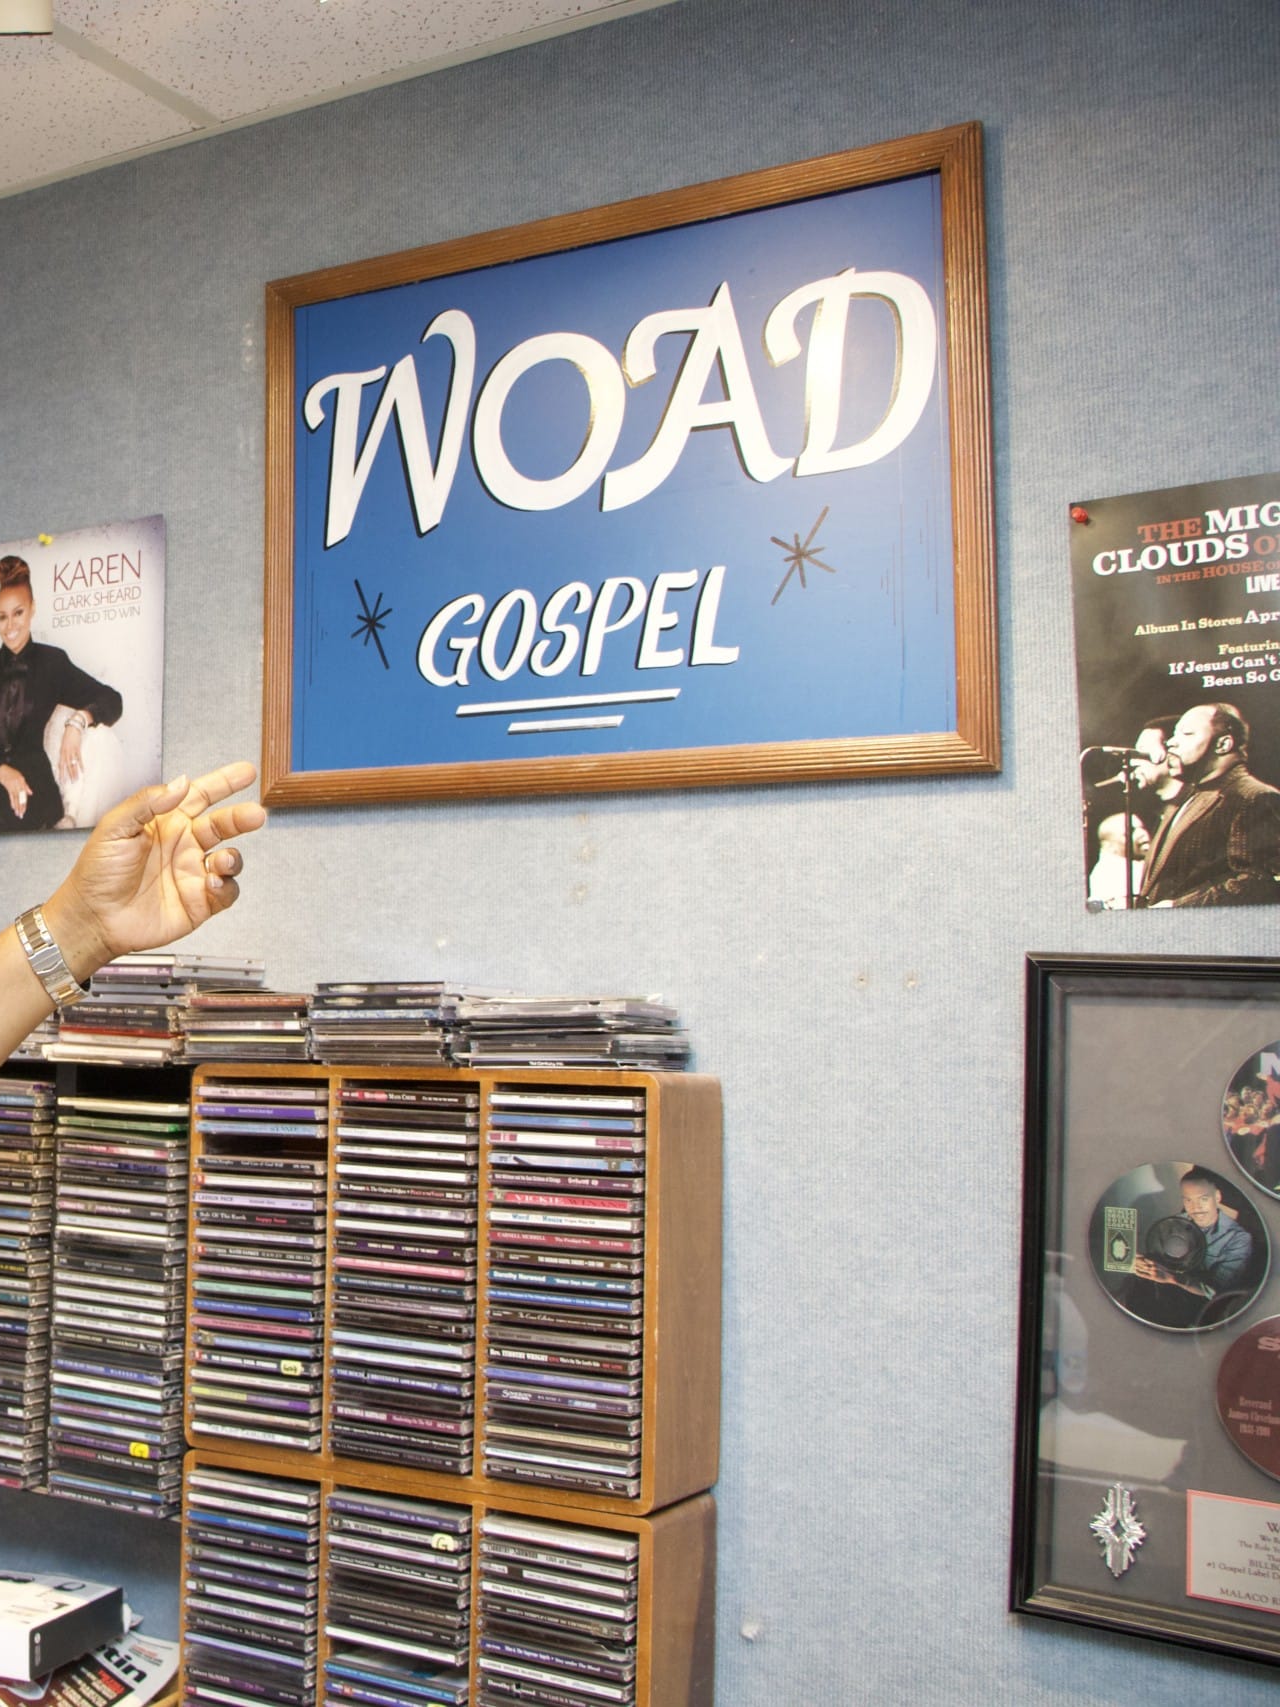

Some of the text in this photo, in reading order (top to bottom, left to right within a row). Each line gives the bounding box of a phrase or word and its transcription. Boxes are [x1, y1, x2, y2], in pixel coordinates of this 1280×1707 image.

[303, 267, 939, 551] WOAD
[1137, 517, 1202, 544] THE
[1092, 533, 1249, 576] CLOUDS
[53, 549, 141, 592] KAREN
[1202, 560, 1265, 579] HOUSE
[1246, 573, 1280, 594] LIVE
[53, 586, 142, 612] CLARK SHEARD
[52, 605, 141, 629] DESTINED TO WIN
[417, 565, 740, 688] GOSPEL
[1134, 624, 1179, 636] Album
[1180, 620, 1196, 631] In
[1198, 617, 1242, 629] Stores
[1218, 640, 1280, 655] Featurin
[1168, 654, 1277, 675] If Jesus Can't
[1202, 675, 1244, 688] Been
[1245, 670, 1267, 684] So
[1219, 1587, 1269, 1603] MALACO
